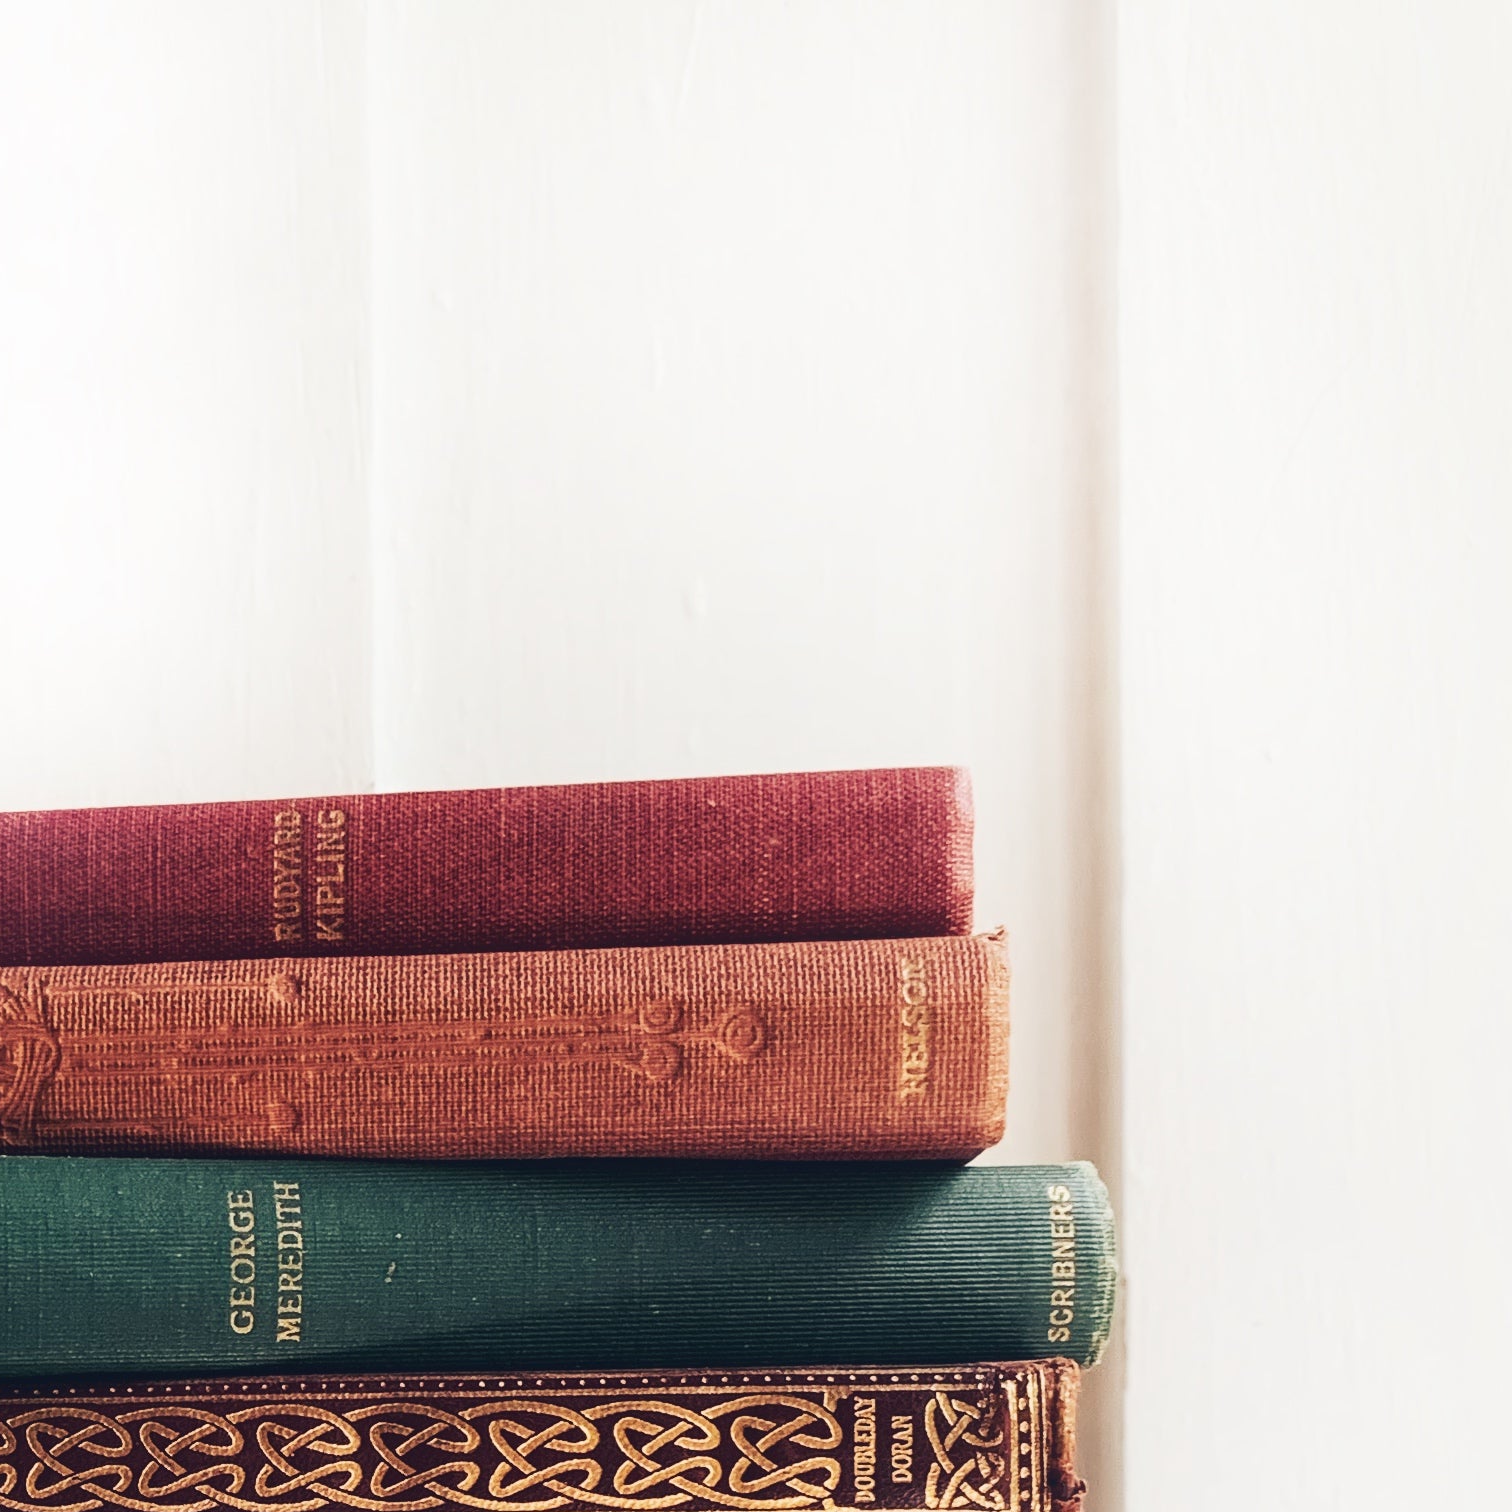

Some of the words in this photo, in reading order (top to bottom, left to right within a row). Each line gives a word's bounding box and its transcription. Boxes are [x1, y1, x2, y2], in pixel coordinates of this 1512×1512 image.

[273, 810, 302, 942] RUDYARD
[316, 809, 345, 942] KIPLING
[900, 958, 929, 1097] NELSON
[226, 1189, 256, 1334] GEORGE
[272, 1180, 303, 1343] MEREDITH
[1047, 1185, 1075, 1342] SCRIBNERS
[854, 1396, 876, 1503] DOUBLEDAY
[891, 1415, 913, 1483] DORAN
